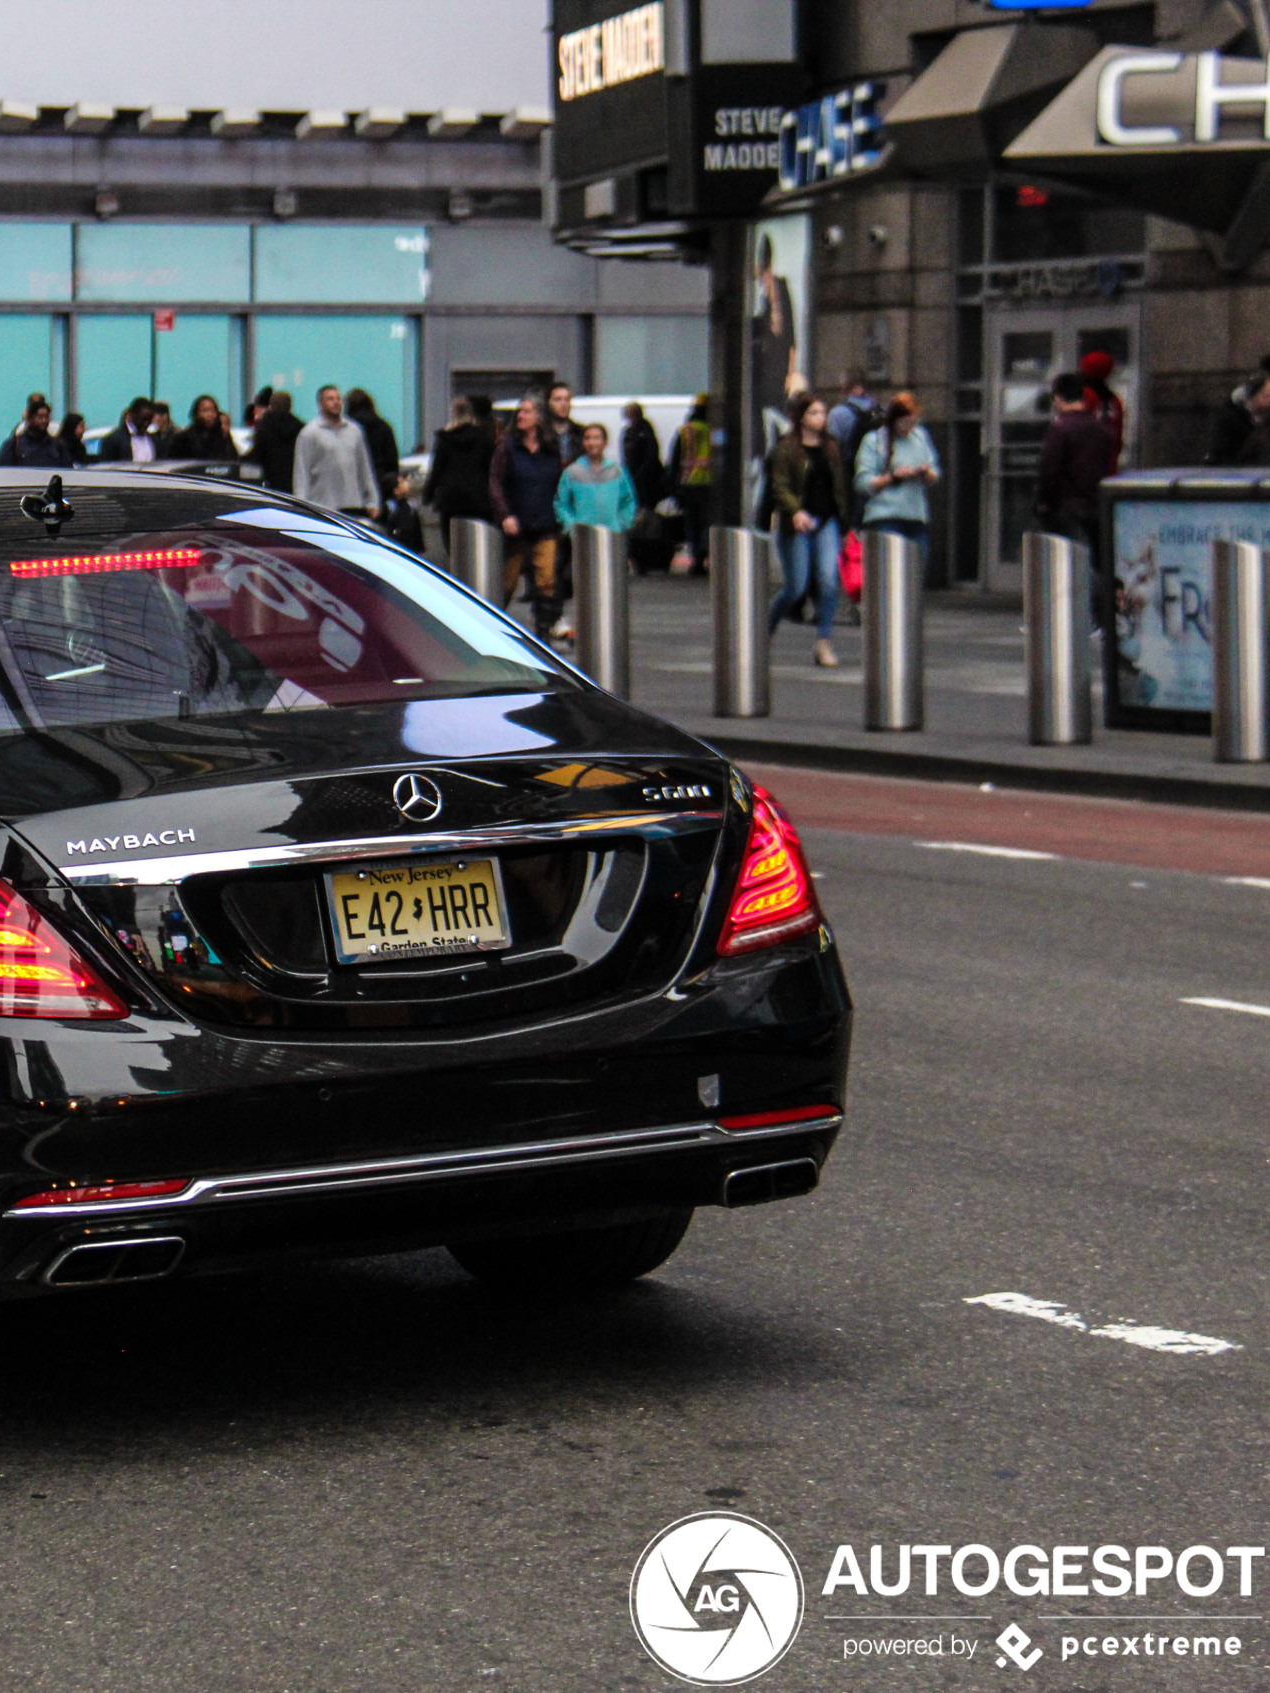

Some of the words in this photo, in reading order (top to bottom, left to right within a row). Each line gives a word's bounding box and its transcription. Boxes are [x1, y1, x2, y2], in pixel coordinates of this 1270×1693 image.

[559, 23, 602, 100] STEVE
[602, 1, 665, 87] MADDEN
[715, 106, 781, 137] STEVE
[704, 140, 780, 171] MADDE
[1160, 565, 1210, 643] FR
[66, 828, 196, 855] MAYBACH
[369, 870, 405, 886] New
[407, 867, 453, 886] Jersey
[341, 890, 409, 940] E42
[426, 882, 493, 931] HRR
[381, 938, 427, 951] Garden
[432, 937, 467, 946] State
